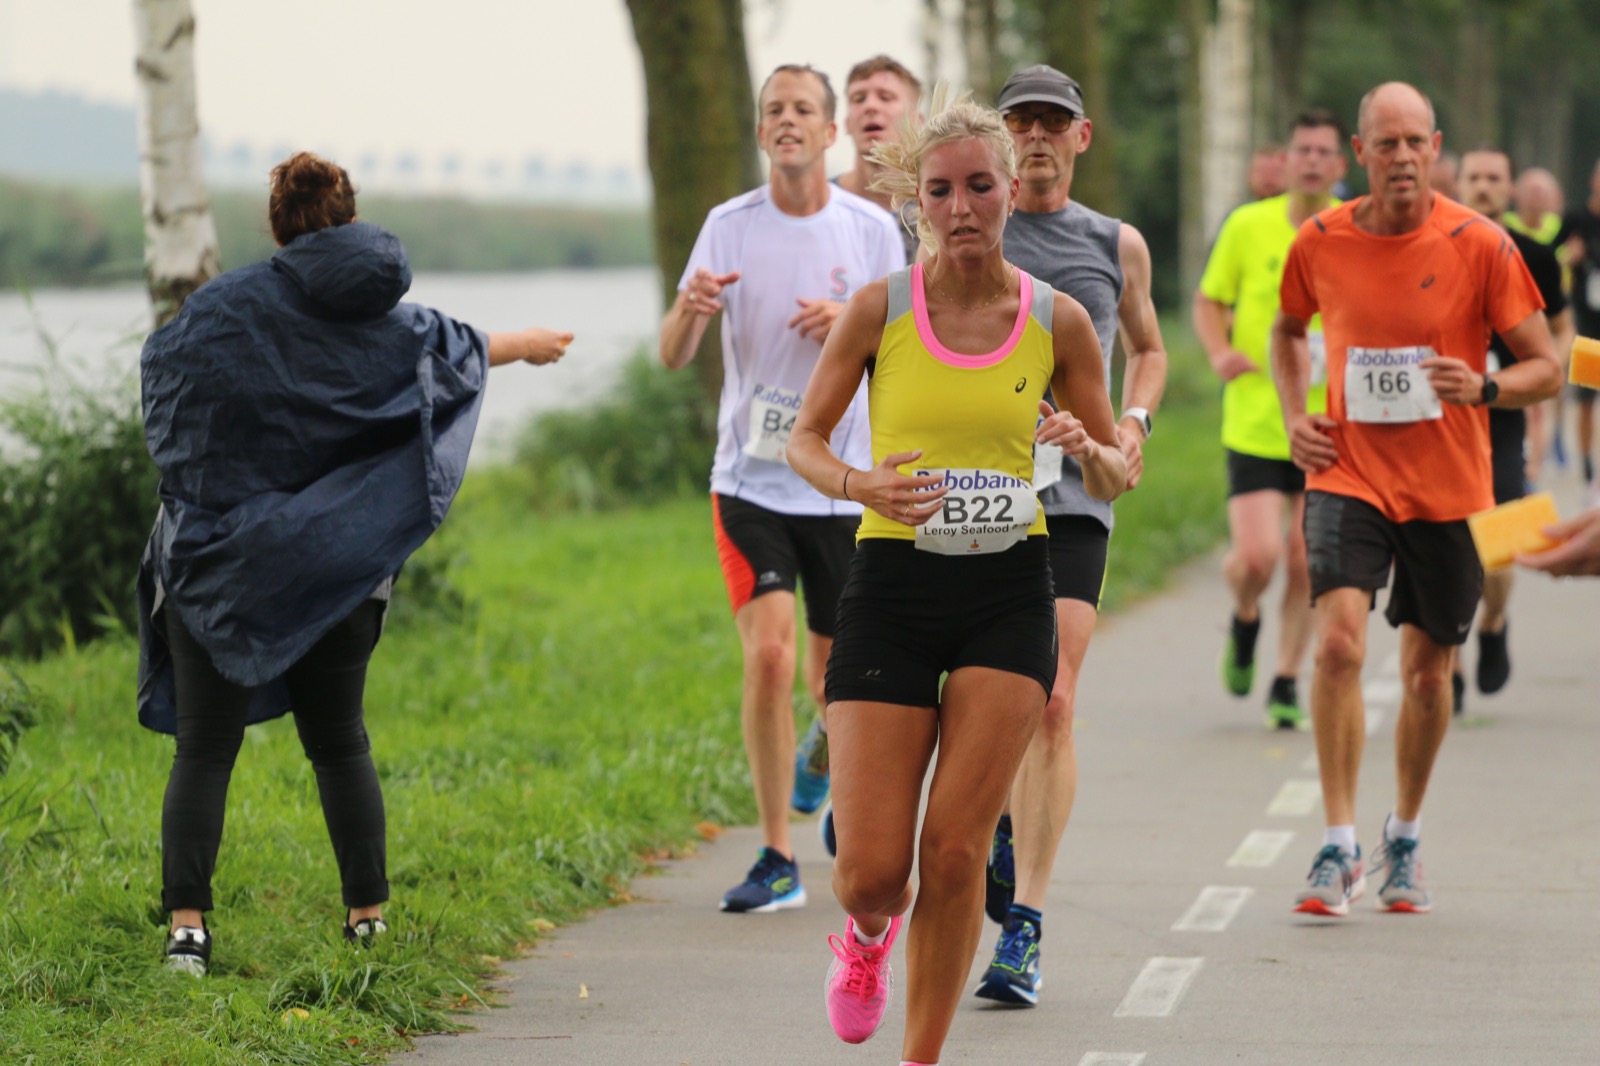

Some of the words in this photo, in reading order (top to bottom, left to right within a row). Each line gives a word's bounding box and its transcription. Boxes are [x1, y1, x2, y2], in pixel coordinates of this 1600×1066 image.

[1363, 371, 1411, 394] 166
[753, 384, 803, 410] Rabob
[763, 409, 797, 432] B4
[942, 494, 1014, 524] B22
[924, 526, 957, 536] Leroy
[961, 524, 1009, 535] Seafood
